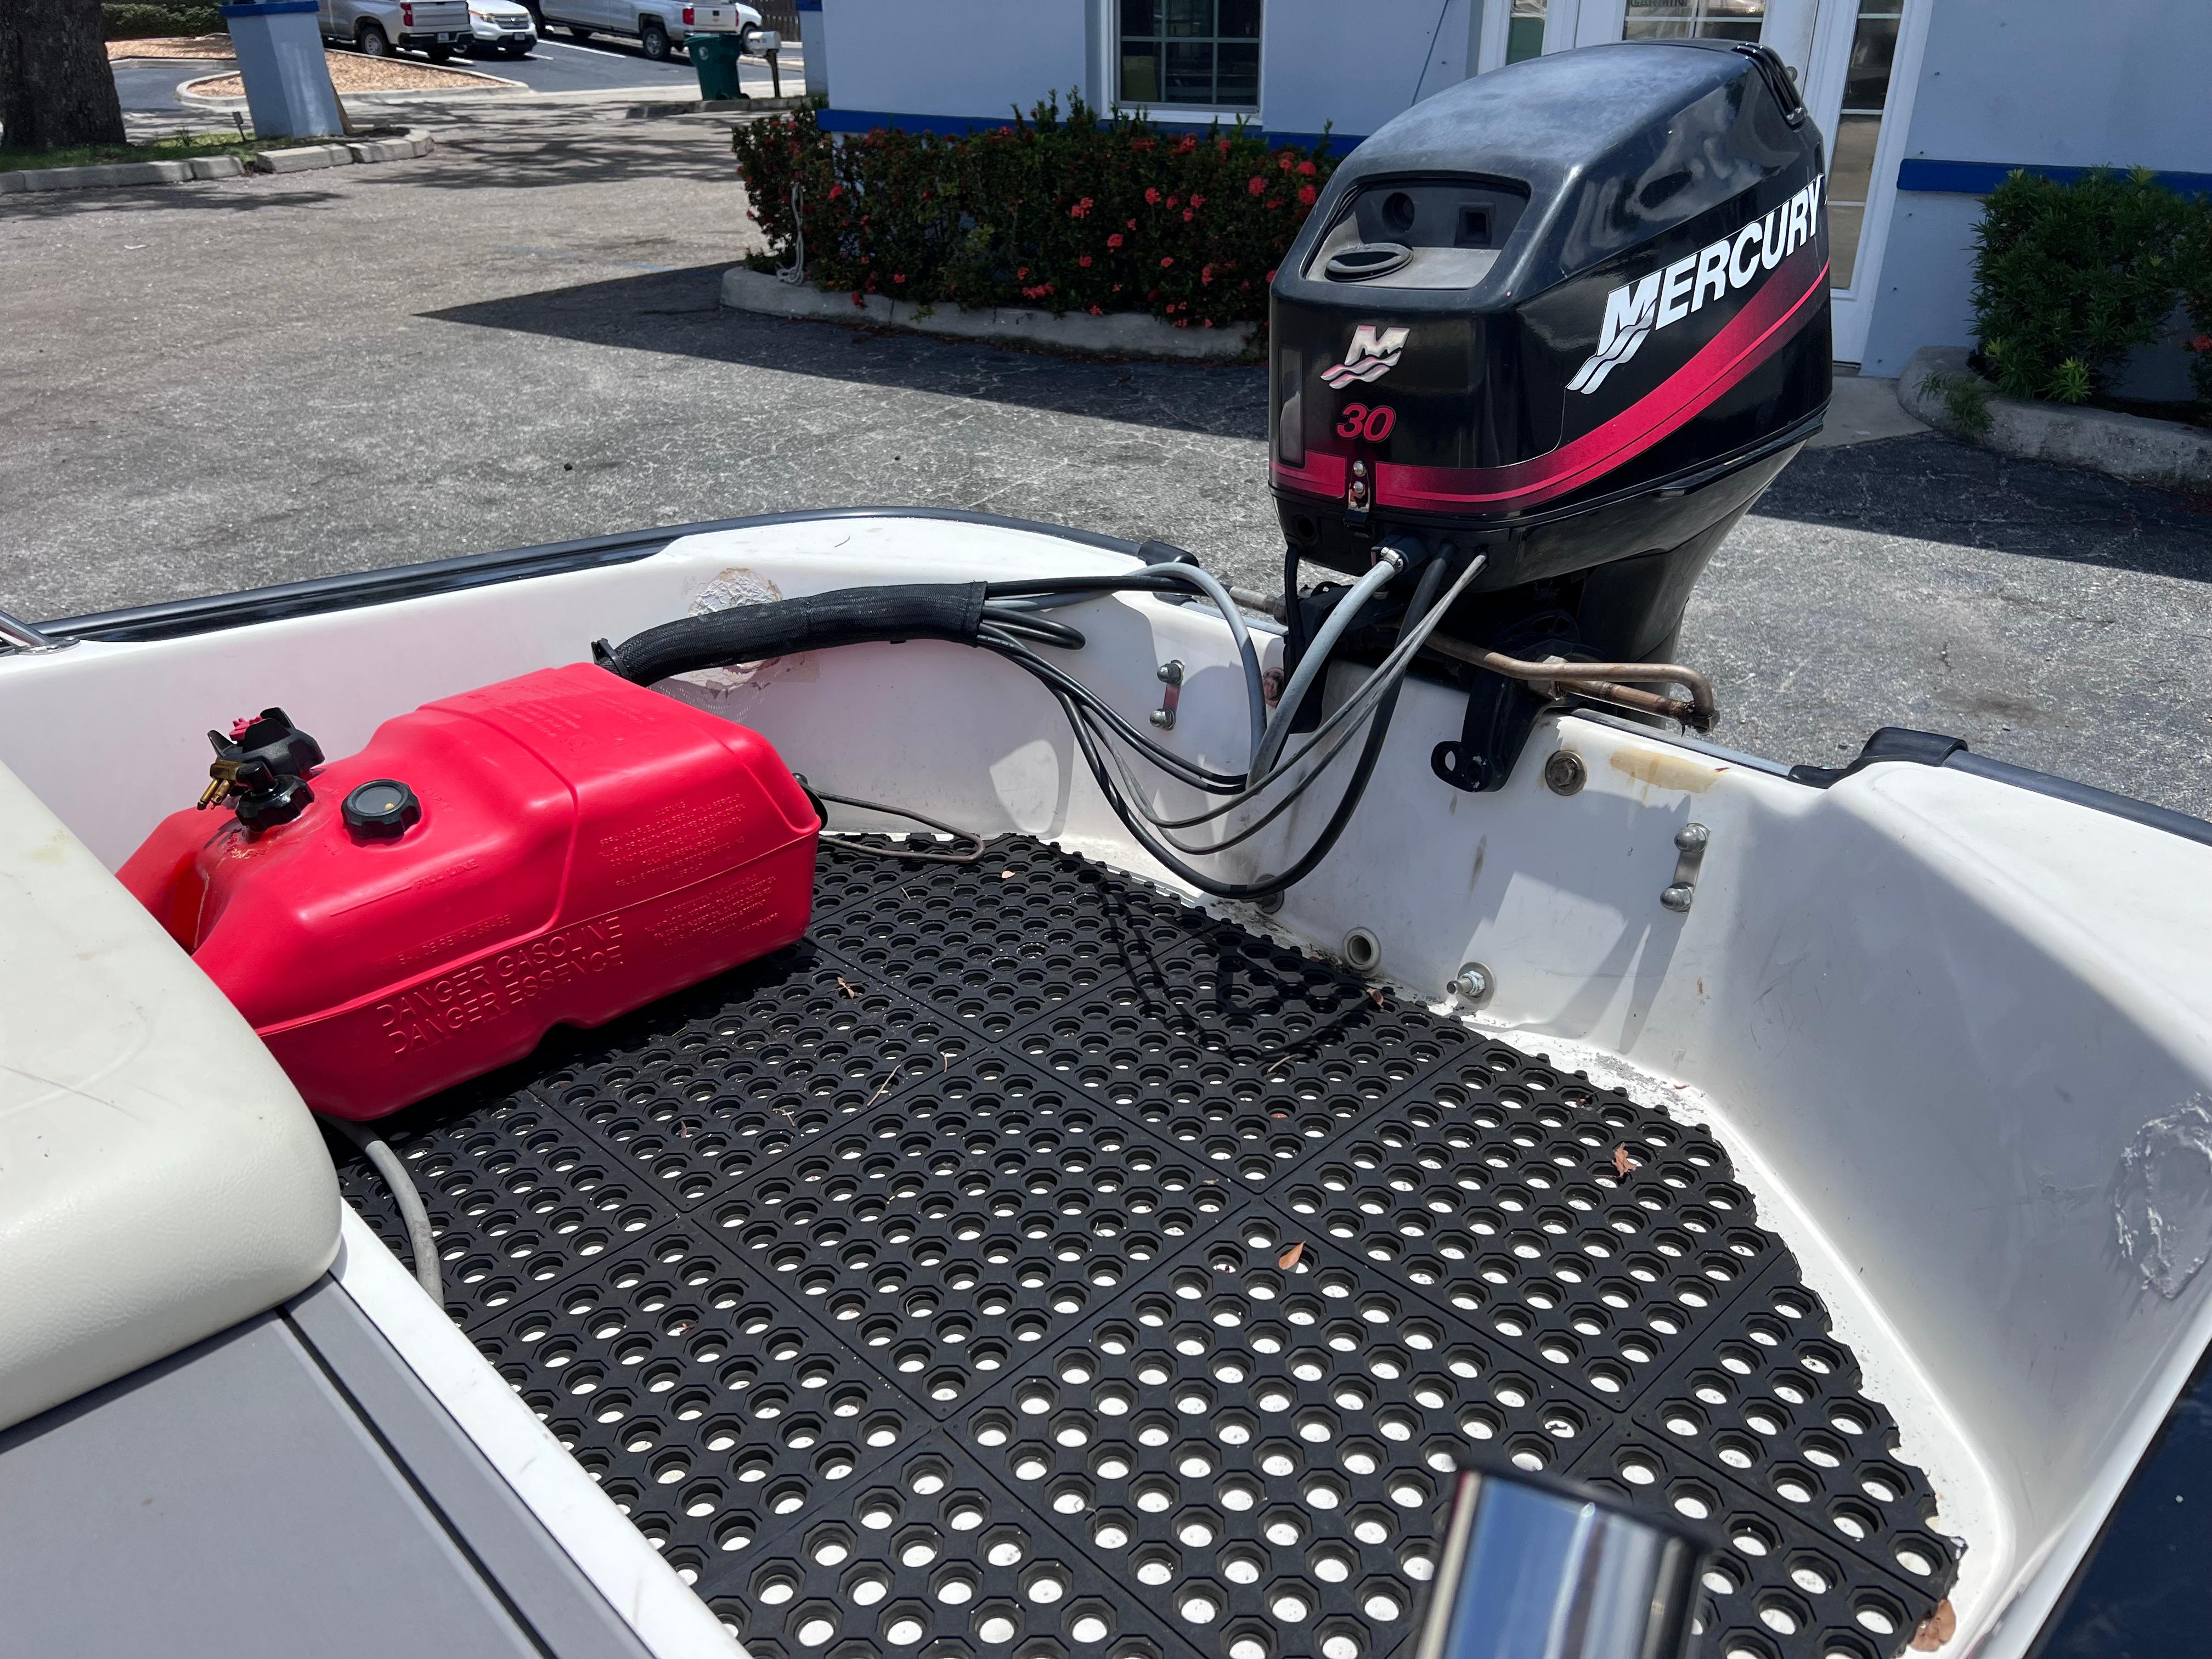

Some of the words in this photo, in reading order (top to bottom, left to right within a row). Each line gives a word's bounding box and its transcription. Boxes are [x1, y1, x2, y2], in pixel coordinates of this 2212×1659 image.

[1596, 173, 1826, 357] MERCURY
[1336, 402, 1397, 443] 30
[446, 859, 478, 877] LINE
[377, 966, 490, 1027] DANGER
[496, 916, 623, 978] GASOLINE
[388, 992, 501, 1054] DANGER
[505, 945, 624, 1005] ESSENCE
